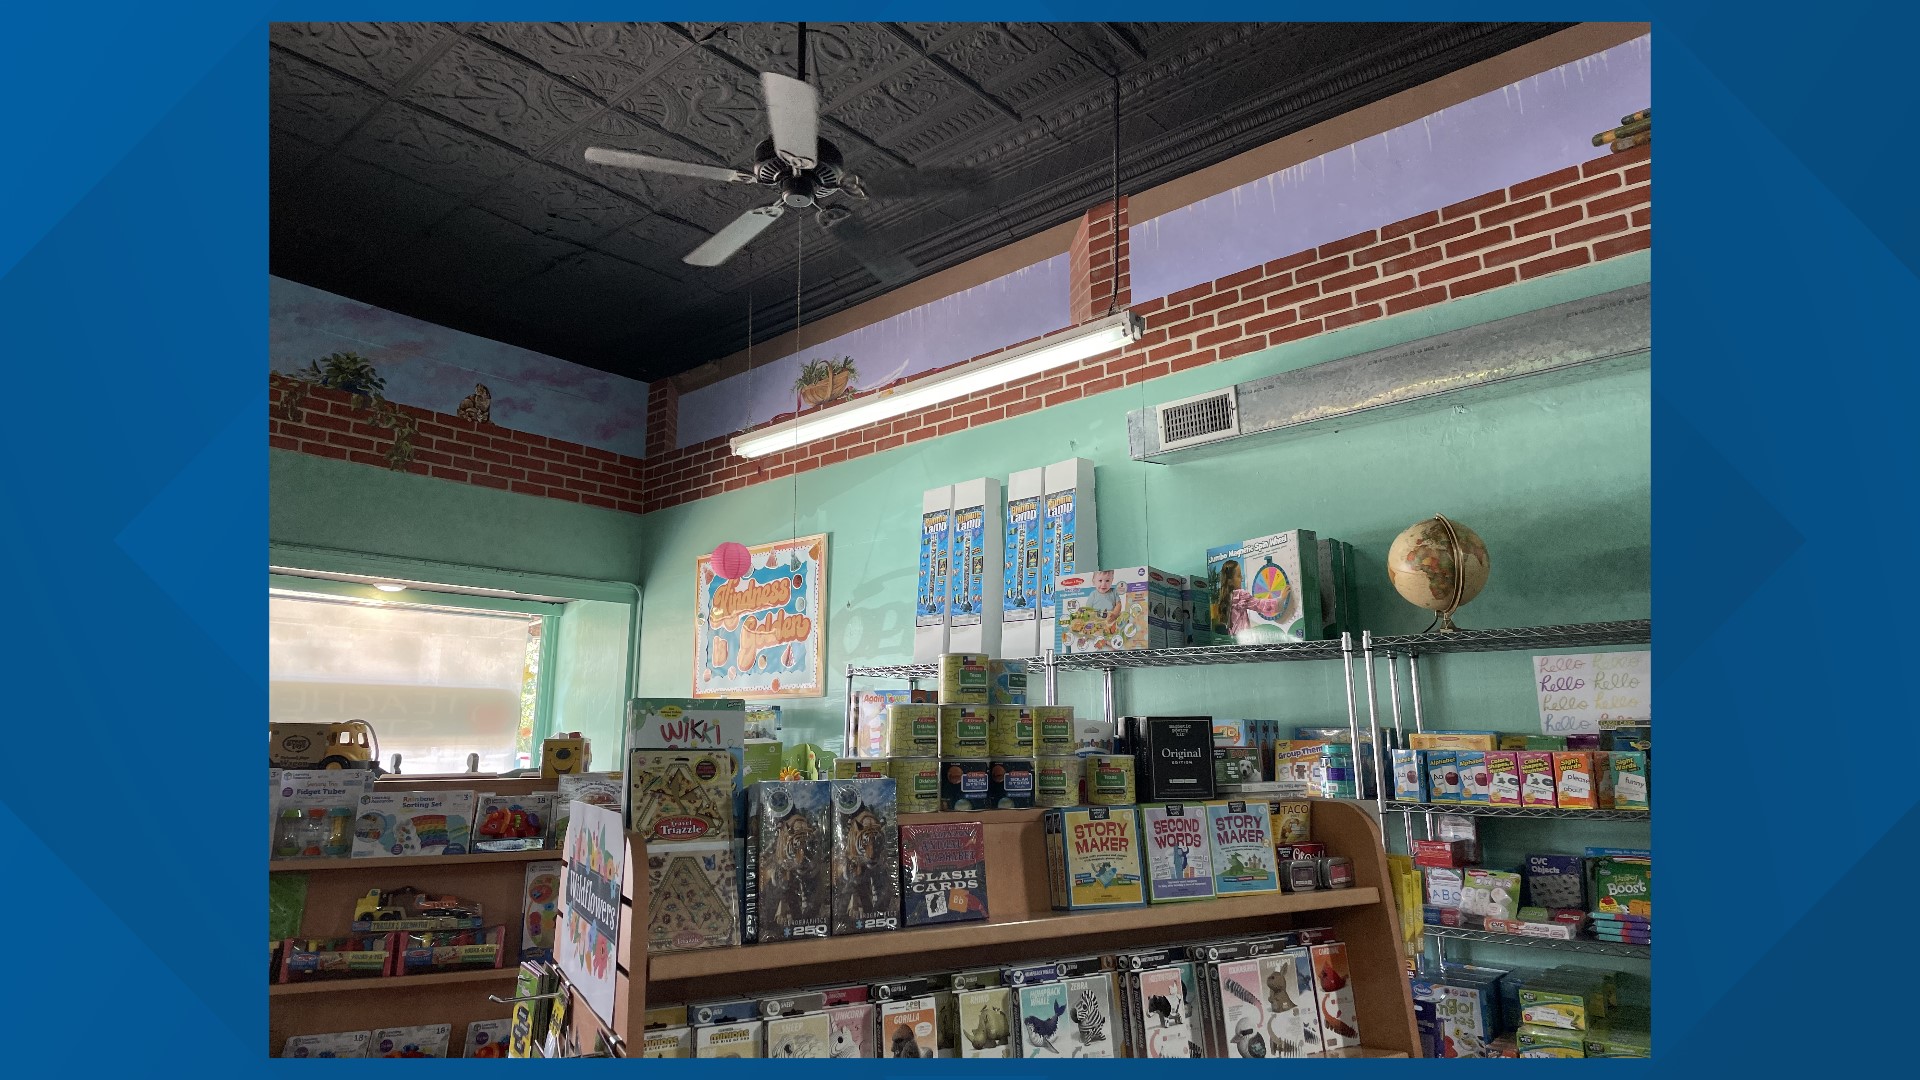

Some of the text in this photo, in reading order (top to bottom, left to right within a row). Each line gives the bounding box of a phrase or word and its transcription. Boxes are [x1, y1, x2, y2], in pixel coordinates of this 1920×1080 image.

[1228, 545, 1254, 558] Magnetic
[1254, 540, 1270, 552] Spin
[1270, 534, 1288, 547] Wheel
[1539, 657, 1586, 673] hello
[1539, 671, 1641, 692] hello hello
[1543, 694, 1589, 711] hello
[1545, 713, 1591, 732] hello
[1161, 747, 1202, 761] Original
[1278, 750, 1301, 760] Group
[1430, 757, 1456, 766] Alphabet
[1560, 758, 1578, 766] Sight
[1560, 763, 1582, 771] Words
[1615, 758, 1633, 766] Sight
[1615, 763, 1637, 771] Words
[1625, 777, 1645, 788] funny
[296, 788, 321, 797] Fidget
[402, 801, 429, 809] Sorting
[1281, 804, 1309, 815] TACO
[1153, 818, 1200, 835] SECOND
[1215, 815, 1262, 832] STORY
[660, 824, 702, 836] Triazzle
[1074, 821, 1128, 840] STORY
[1154, 833, 1201, 849] WORDS
[1216, 830, 1264, 846] MAKER
[1075, 837, 1129, 855] MAKER
[1530, 857, 1548, 866] CVC
[912, 869, 977, 883] FLASH
[1531, 866, 1560, 875] Objects
[912, 879, 979, 893] CARDS
[1606, 880, 1647, 896] Boost
[570, 869, 616, 931] Wildflowers
[864, 917, 898, 929] 250
[793, 925, 828, 937] 250
[1029, 987, 1060, 998] HUMPBACK
[1070, 982, 1088, 991] ZEBRA
[970, 995, 989, 1004] RHINO
[1030, 996, 1050, 1006] WHALE
[834, 1009, 865, 1021] UNICORN
[893, 1014, 920, 1025] GORILLA
